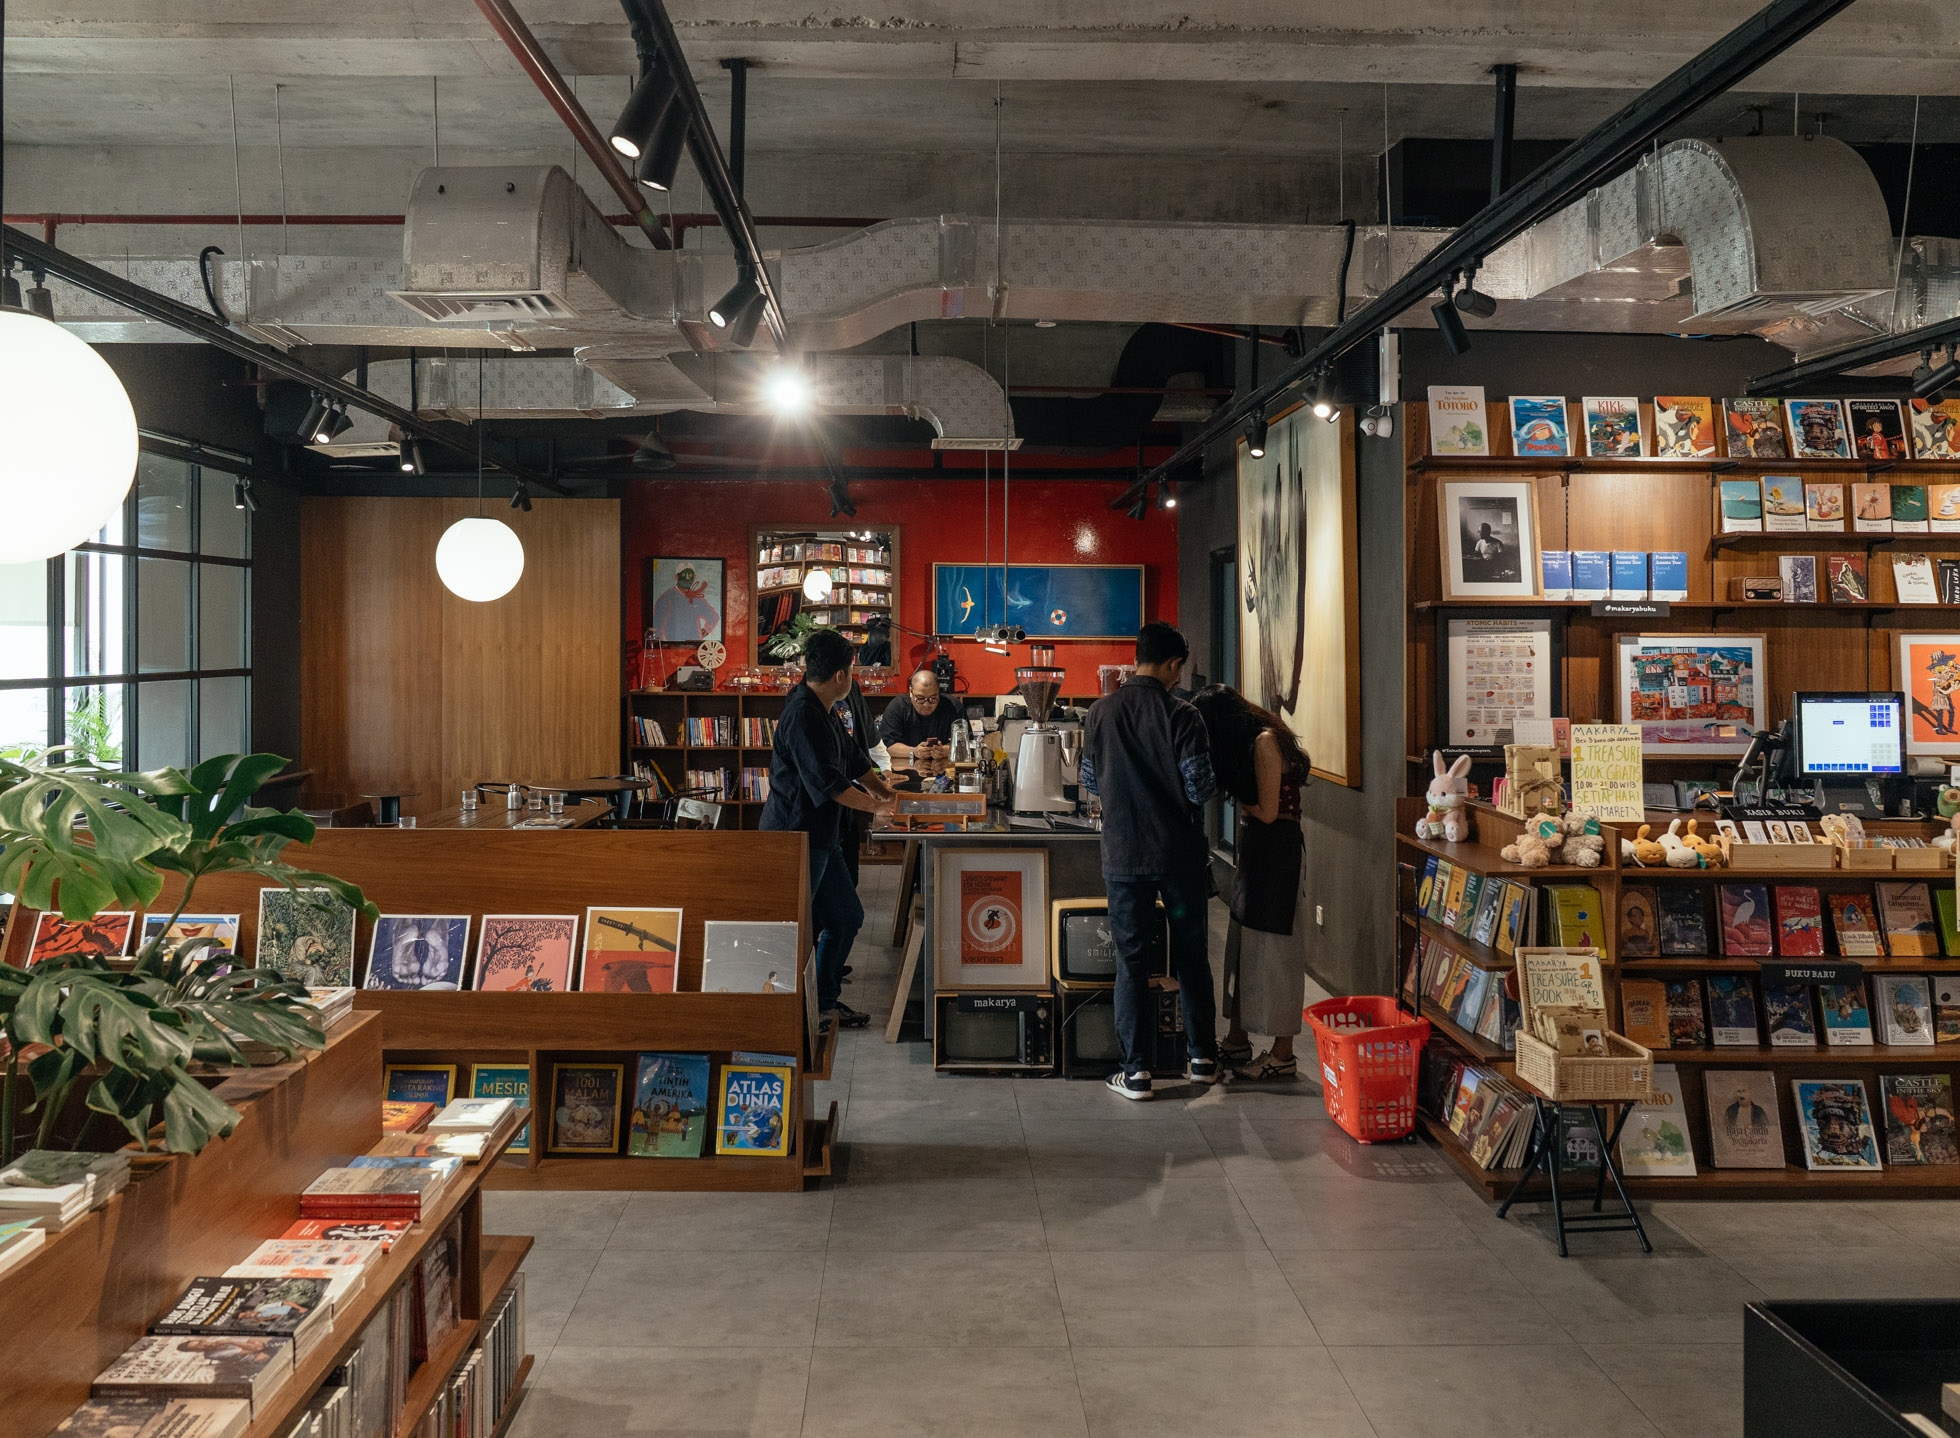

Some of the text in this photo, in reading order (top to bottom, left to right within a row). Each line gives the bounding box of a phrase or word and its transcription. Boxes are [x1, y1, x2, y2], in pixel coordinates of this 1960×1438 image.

[1436, 400, 1478, 410] TOTORO
[1605, 605, 1656, 613] @makaryabuku
[1573, 746, 1640, 764] 1 TREASURE
[1575, 764, 1642, 782] BOOK GRATIS
[1575, 790, 1640, 804] SETIAP HARI
[1601, 806, 1629, 818] MARET
[1580, 963, 1592, 979] 1
[1785, 970, 1810, 978] BUKU
[1529, 972, 1580, 988] TREASURE
[1533, 988, 1562, 1004] BOOK
[974, 997, 1016, 1008] makarya
[576, 1077, 600, 1088] 1001
[658, 1077, 689, 1086] TINTIN
[728, 1080, 781, 1094] ATLAS
[1895, 1079, 1942, 1087] CASTLE
[482, 1082, 528, 1095] MESIR
[565, 1088, 609, 1098] MALAM
[651, 1088, 692, 1098] AMERIKA
[728, 1094, 781, 1108] DUNIA
[1729, 1136, 1768, 1147] Yogyakarta
